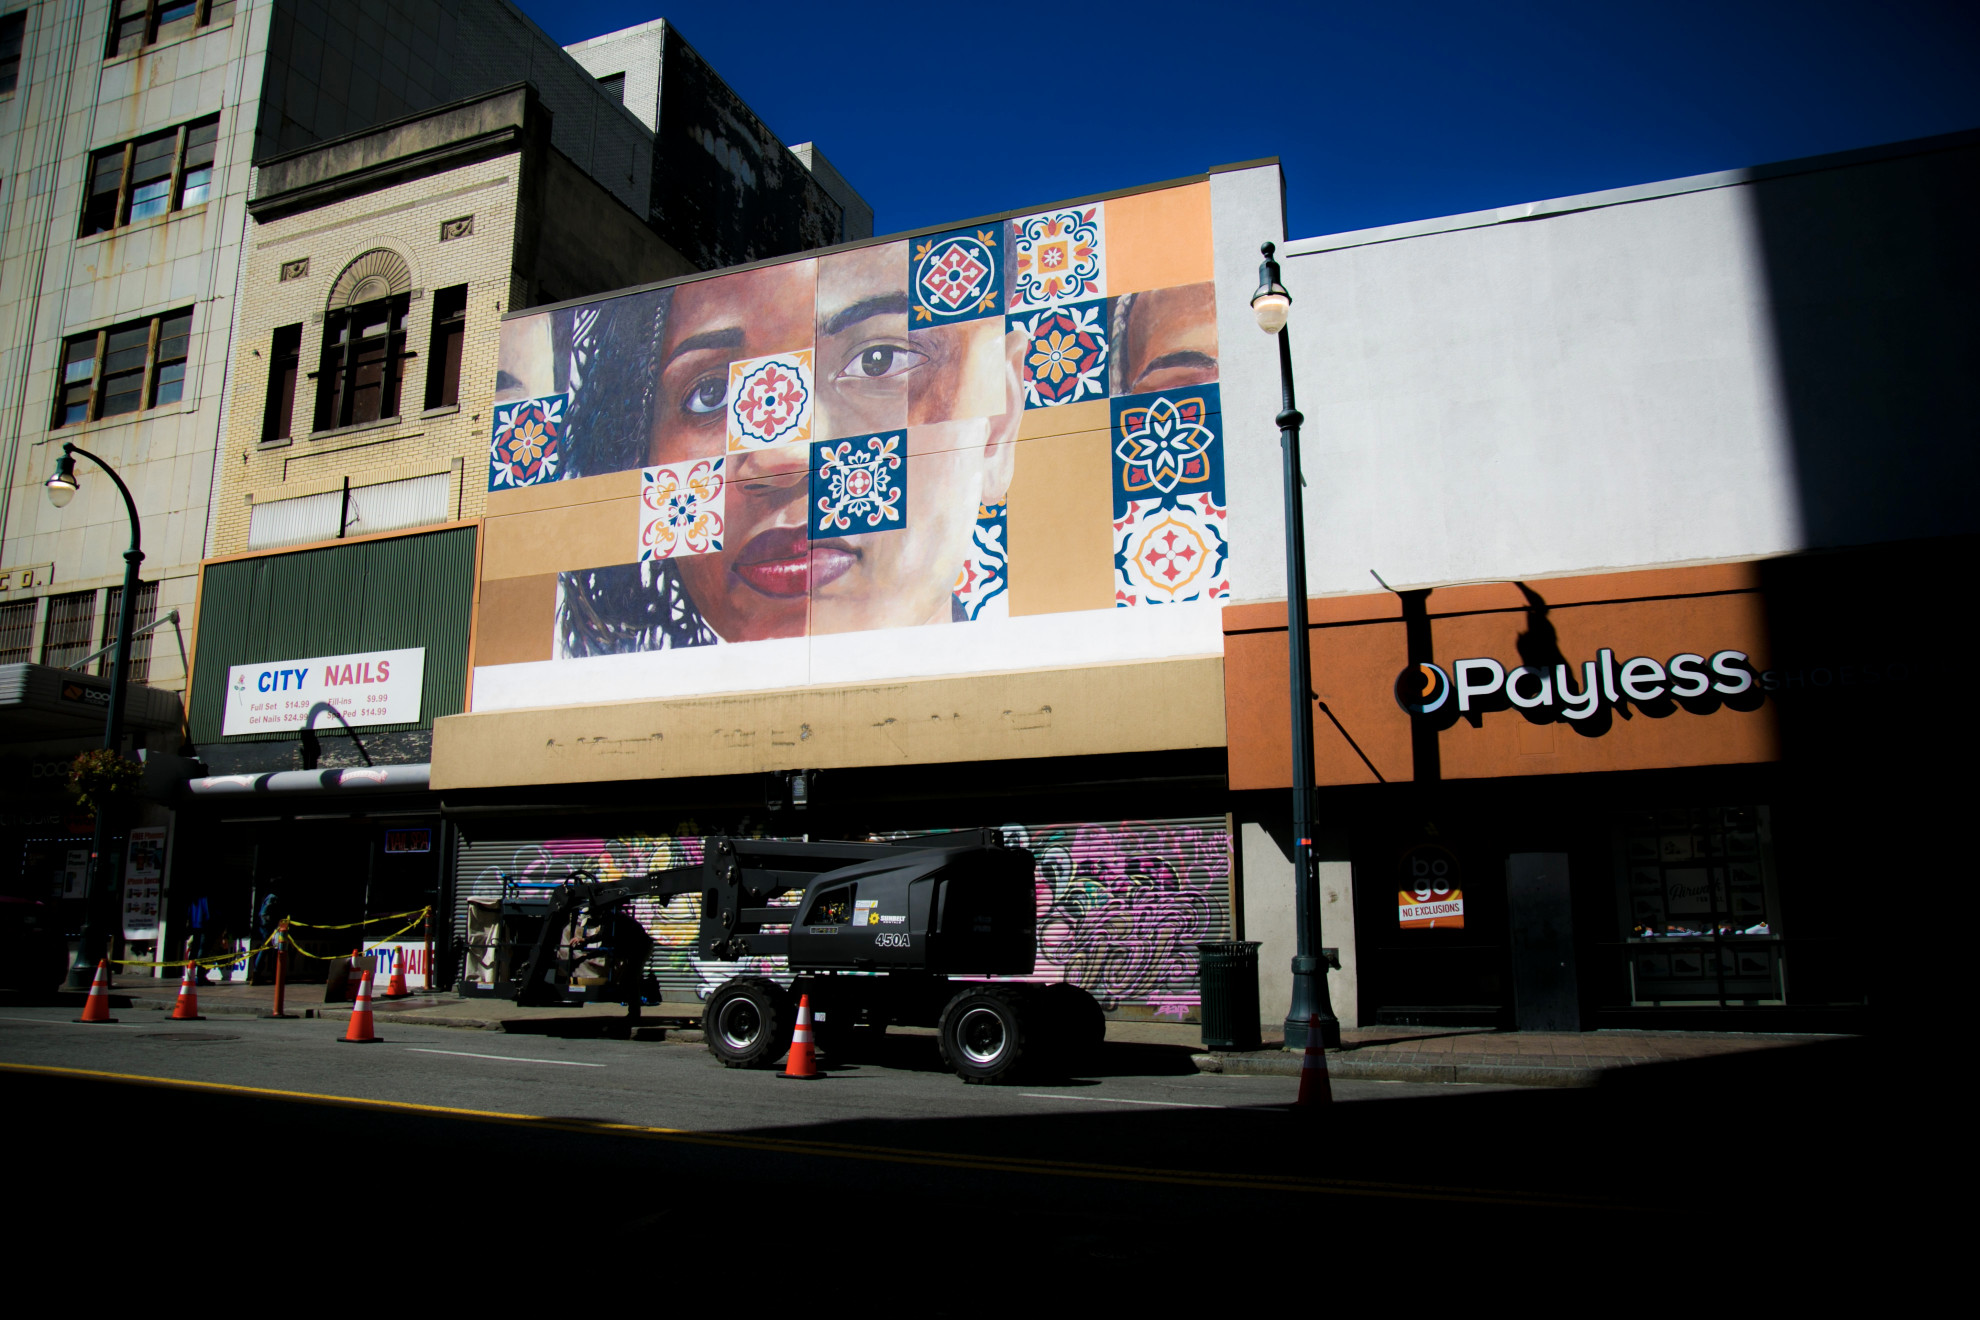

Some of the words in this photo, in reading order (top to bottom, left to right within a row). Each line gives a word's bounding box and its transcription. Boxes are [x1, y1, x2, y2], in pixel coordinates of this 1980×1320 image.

[258, 668, 309, 692] CITY
[324, 661, 390, 687] NAILS
[1454, 648, 1753, 720] Payless
[250, 703, 263, 712] Full
[265, 703, 277, 711] Set
[285, 700, 310, 709] $14.99
[328, 698, 352, 706] Fill-ins
[366, 694, 388, 703] $9.99
[249, 716, 261, 724] Gel
[263, 714, 281, 723] Nails
[284, 713, 308, 722] $24.99
[327, 711, 341, 720] Spa
[343, 709, 357, 718] Ped
[361, 707, 387, 717] $14.99
[387, 832, 408, 851] NAIL
[410, 831, 428, 850] SPA
[1402, 908, 1413, 917] NO
[1415, 903, 1460, 916] EXCLUSIONS
[875, 932, 911, 947] 450A
